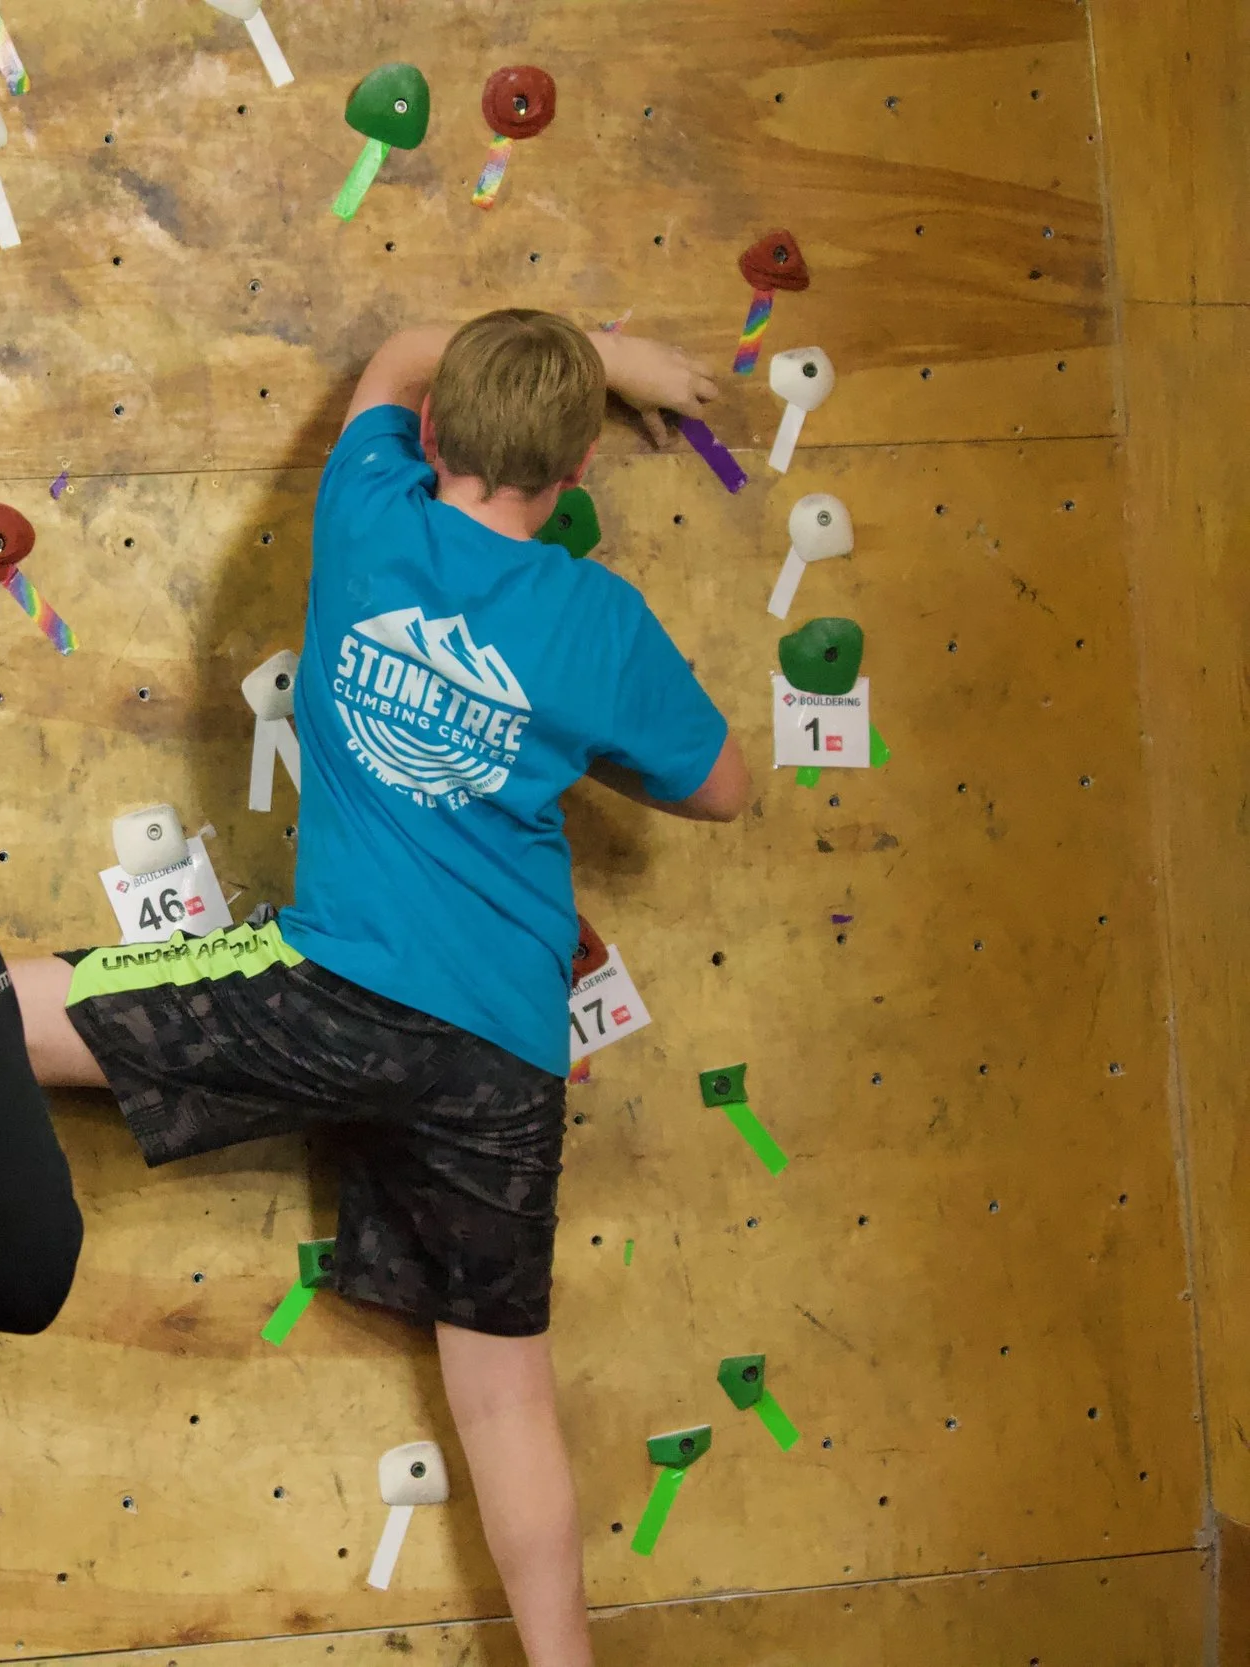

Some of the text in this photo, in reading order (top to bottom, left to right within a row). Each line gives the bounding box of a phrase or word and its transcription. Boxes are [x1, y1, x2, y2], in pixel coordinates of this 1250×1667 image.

[337, 634, 531, 751] STONETREE
[799, 695, 861, 707] BOULDERING
[333, 678, 516, 766] CLIMBING CENTER
[804, 717, 820, 751] 1
[132, 855, 194, 889] BOULDERING
[138, 887, 186, 931] 46
[570, 997, 606, 1045] 17
